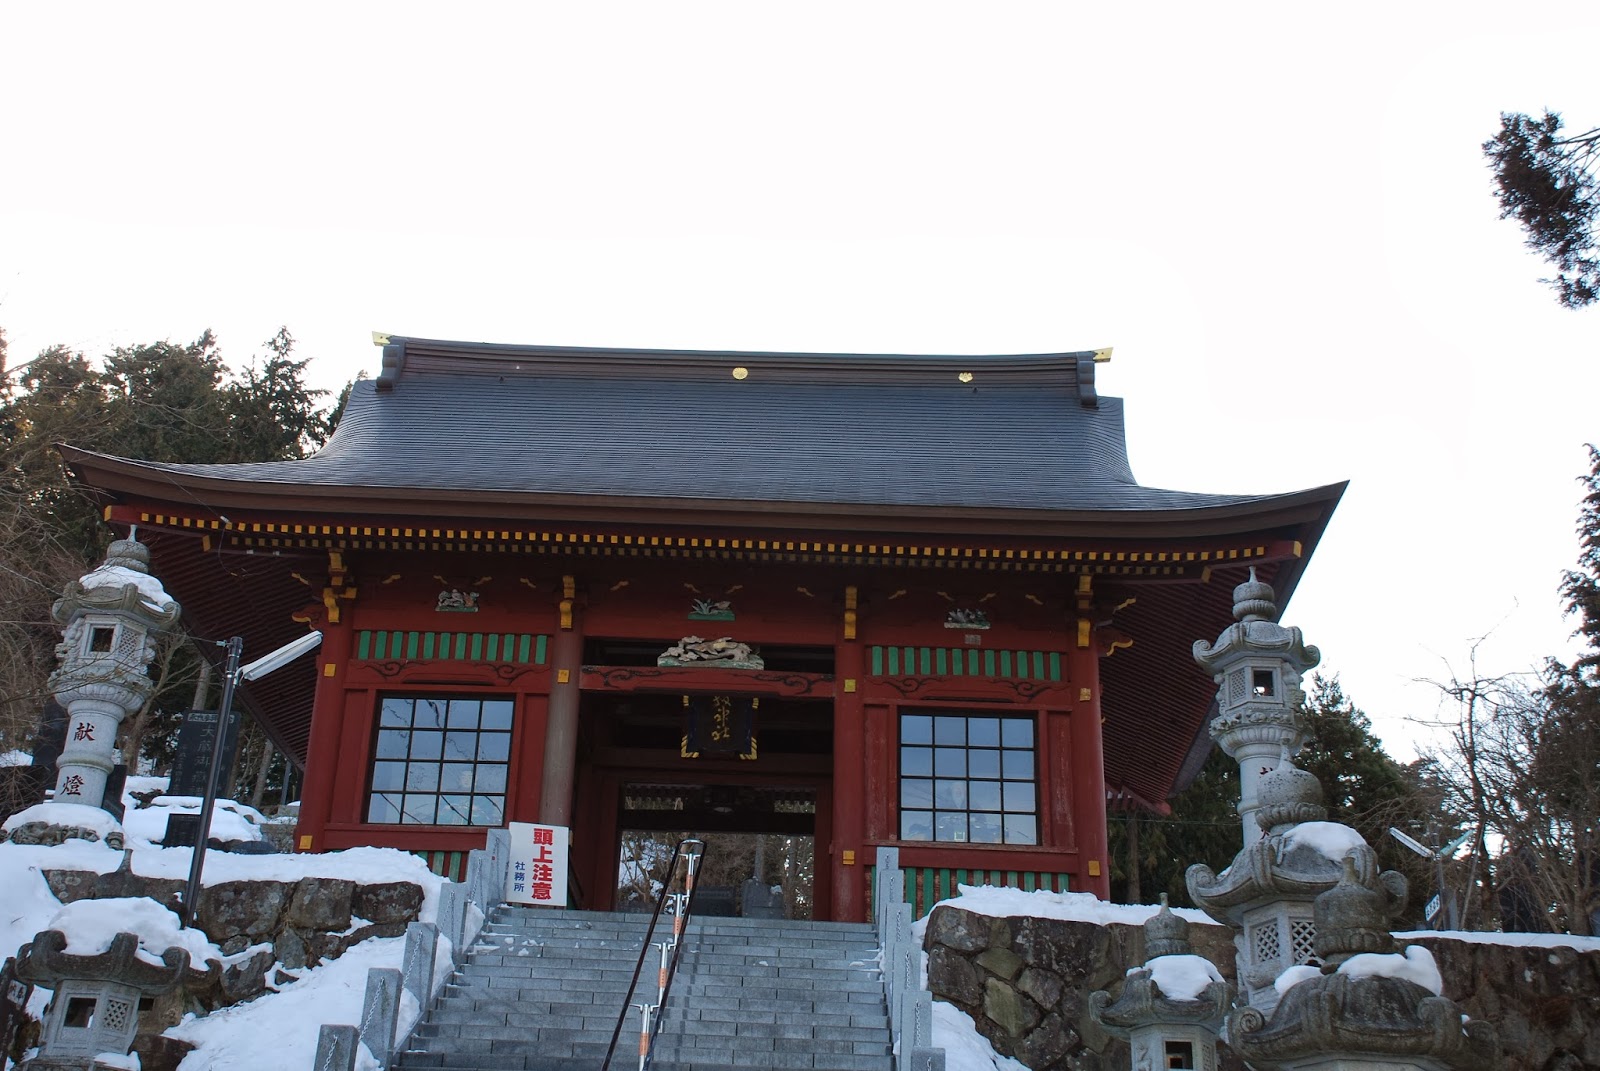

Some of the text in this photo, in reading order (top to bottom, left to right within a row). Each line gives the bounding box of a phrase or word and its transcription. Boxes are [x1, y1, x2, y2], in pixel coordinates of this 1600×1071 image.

[60, 722, 95, 796] 献燈
[513, 860, 526, 892] 社務所
[531, 827, 554, 900] 頭上注意
